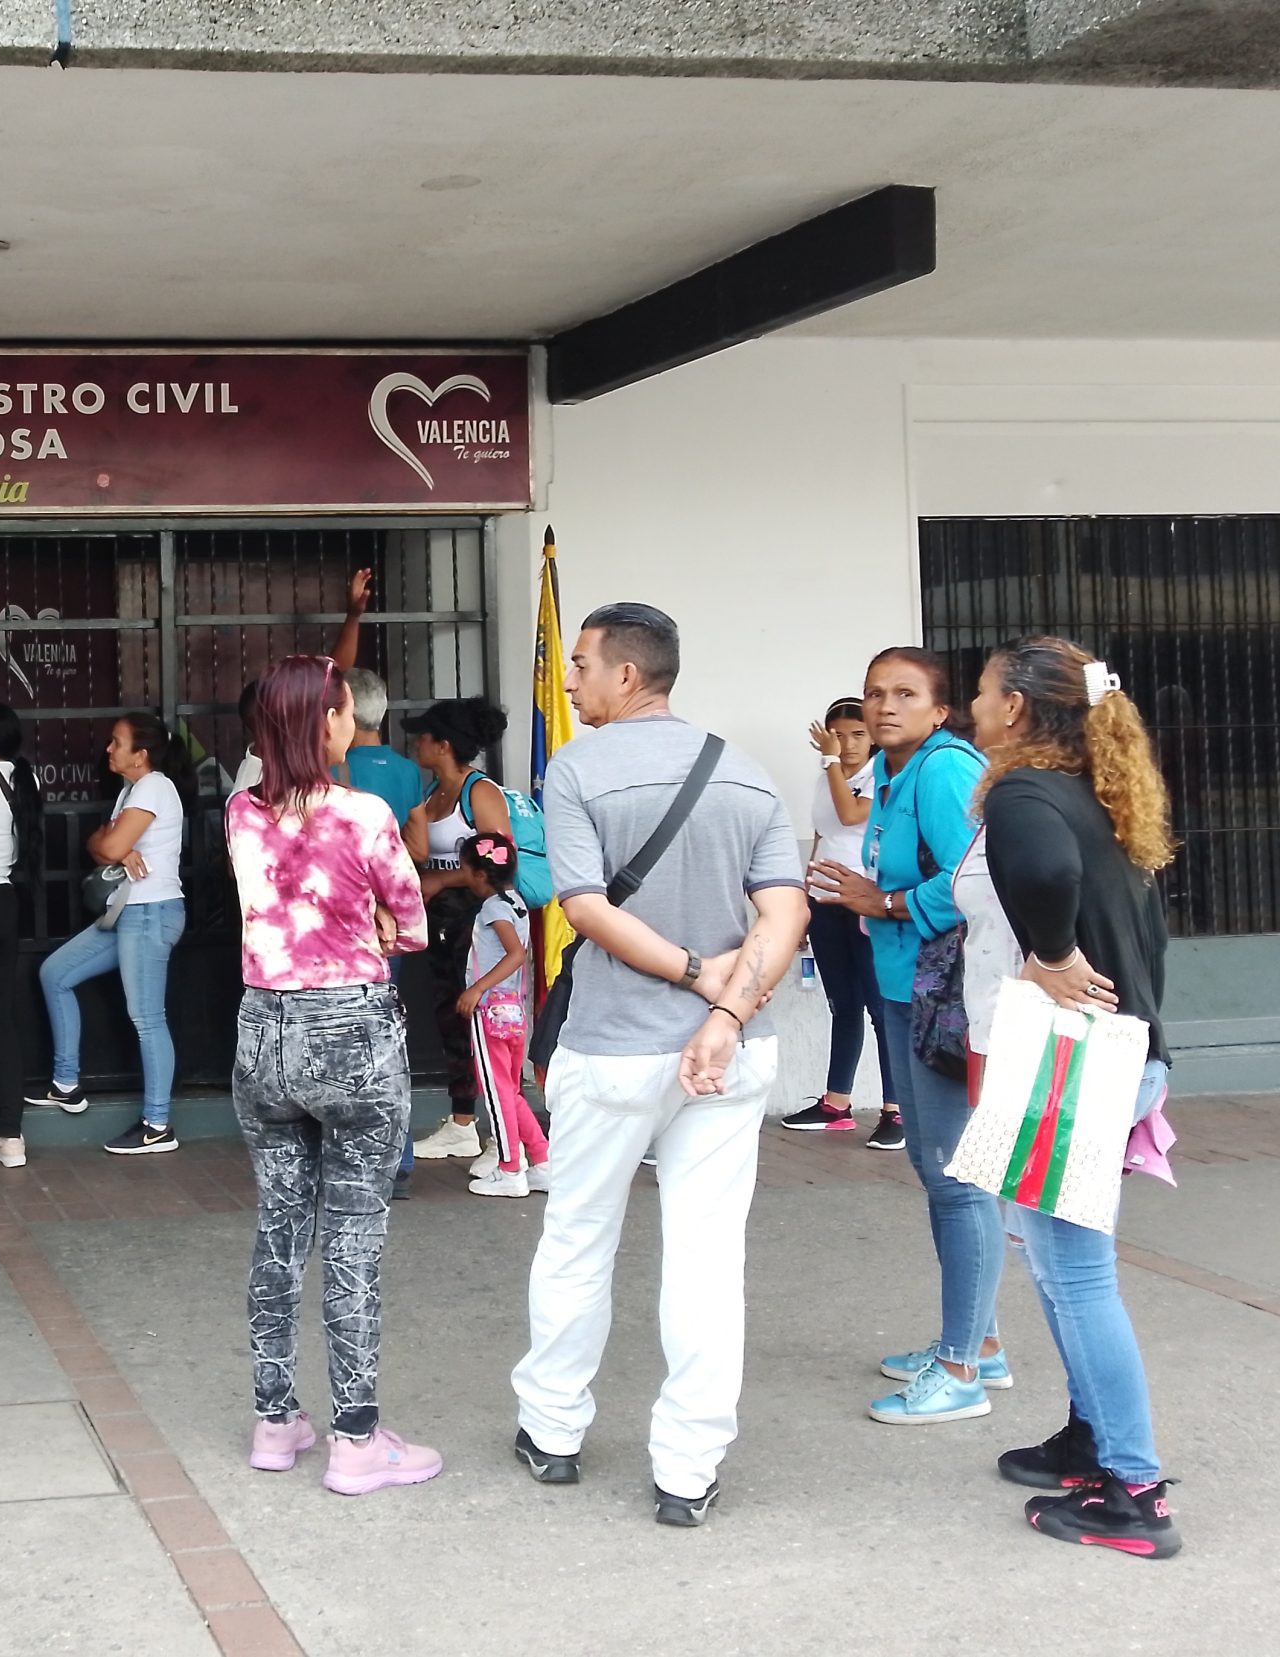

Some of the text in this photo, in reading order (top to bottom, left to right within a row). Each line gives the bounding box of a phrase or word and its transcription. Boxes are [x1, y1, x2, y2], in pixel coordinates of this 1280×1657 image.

[126, 382, 239, 415] CIVIL
[417, 420, 510, 444] VALENCIA
[453, 444, 510, 464] Te quiero
